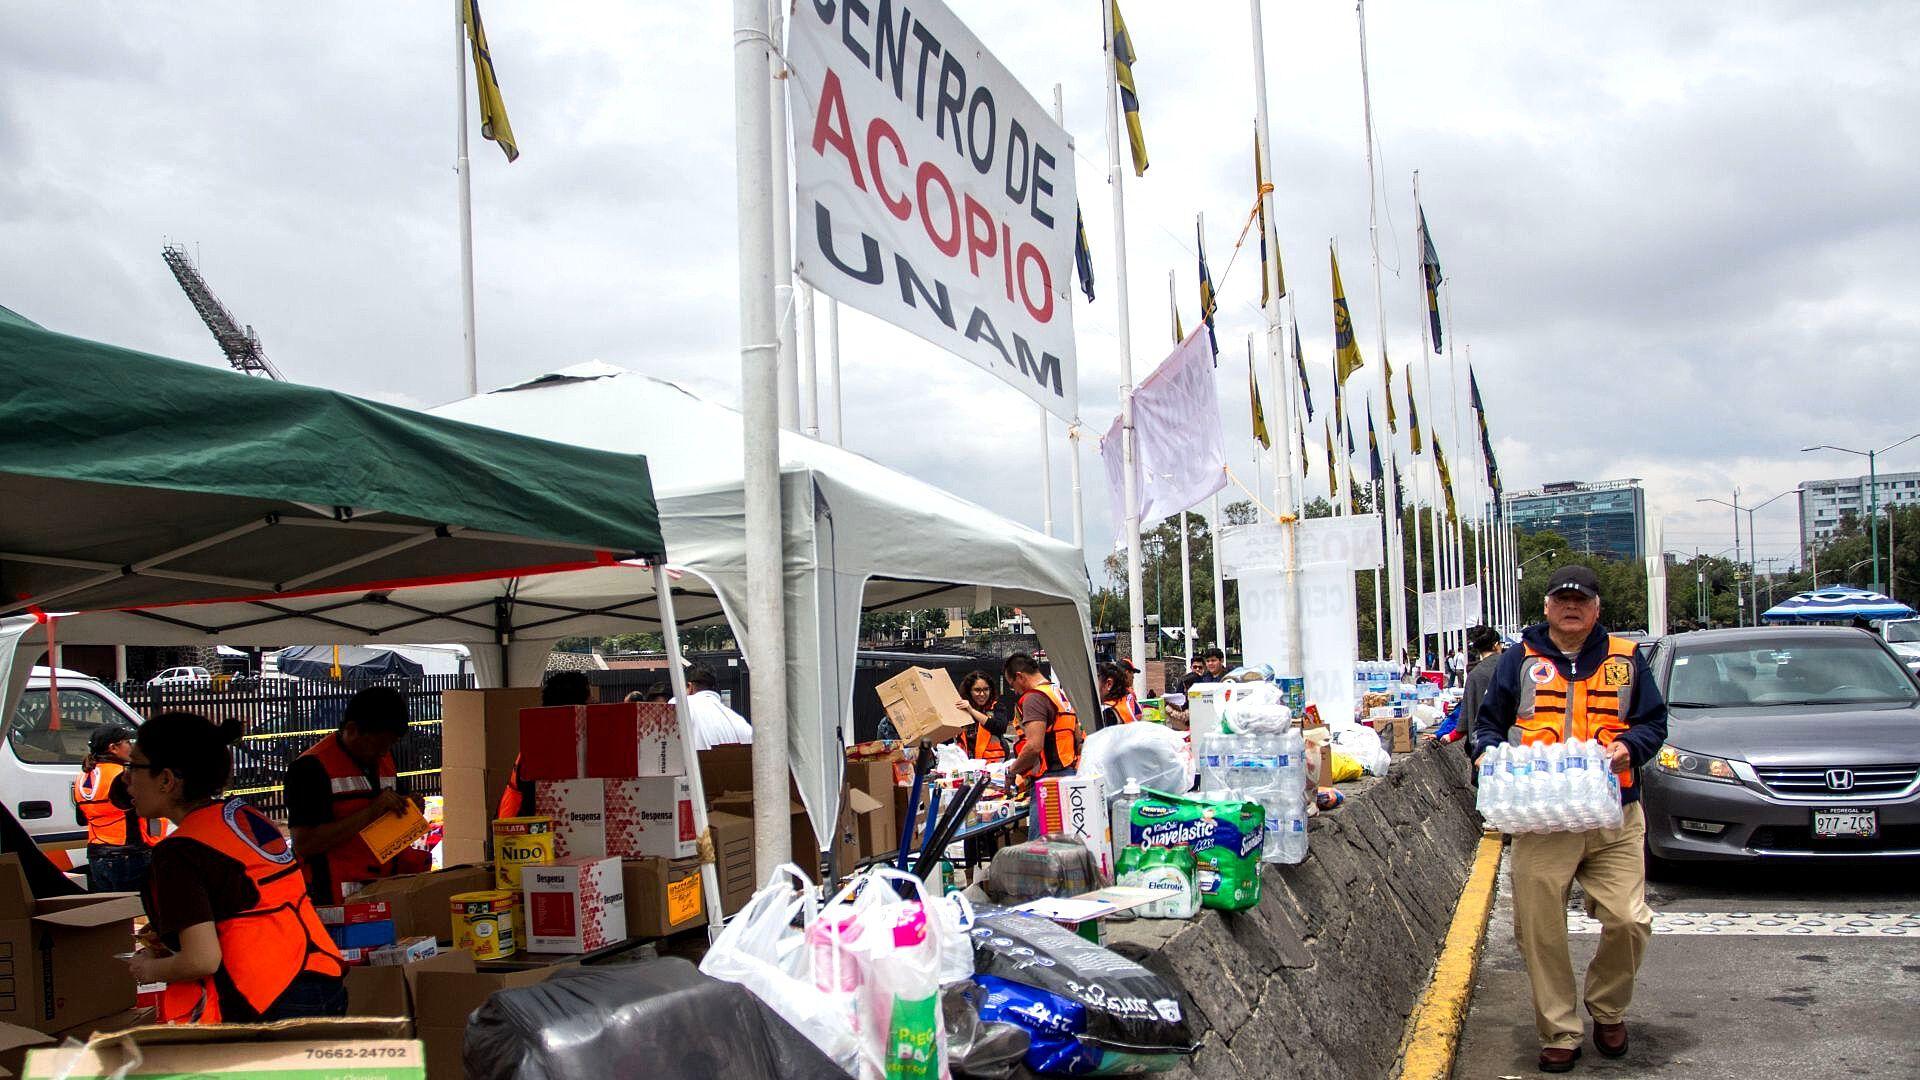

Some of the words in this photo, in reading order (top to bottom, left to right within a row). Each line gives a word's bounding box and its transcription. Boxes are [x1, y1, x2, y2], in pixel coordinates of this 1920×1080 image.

[1005, 118, 1055, 229] DE
[812, 67, 1053, 323] ACOPIO
[815, 200, 1063, 397] UNAM
[570, 811, 601, 822] Despensa
[641, 810, 673, 822] Despensa
[1069, 785, 1088, 836] kotex
[1817, 816, 1873, 830] 977-ZCS
[1141, 819, 1217, 850] Suavelastic
[502, 846, 542, 861] NIDO
[536, 874, 565, 884] Despensa
[1148, 881, 1184, 892] Electrolit
[603, 892, 623, 905] Despensa
